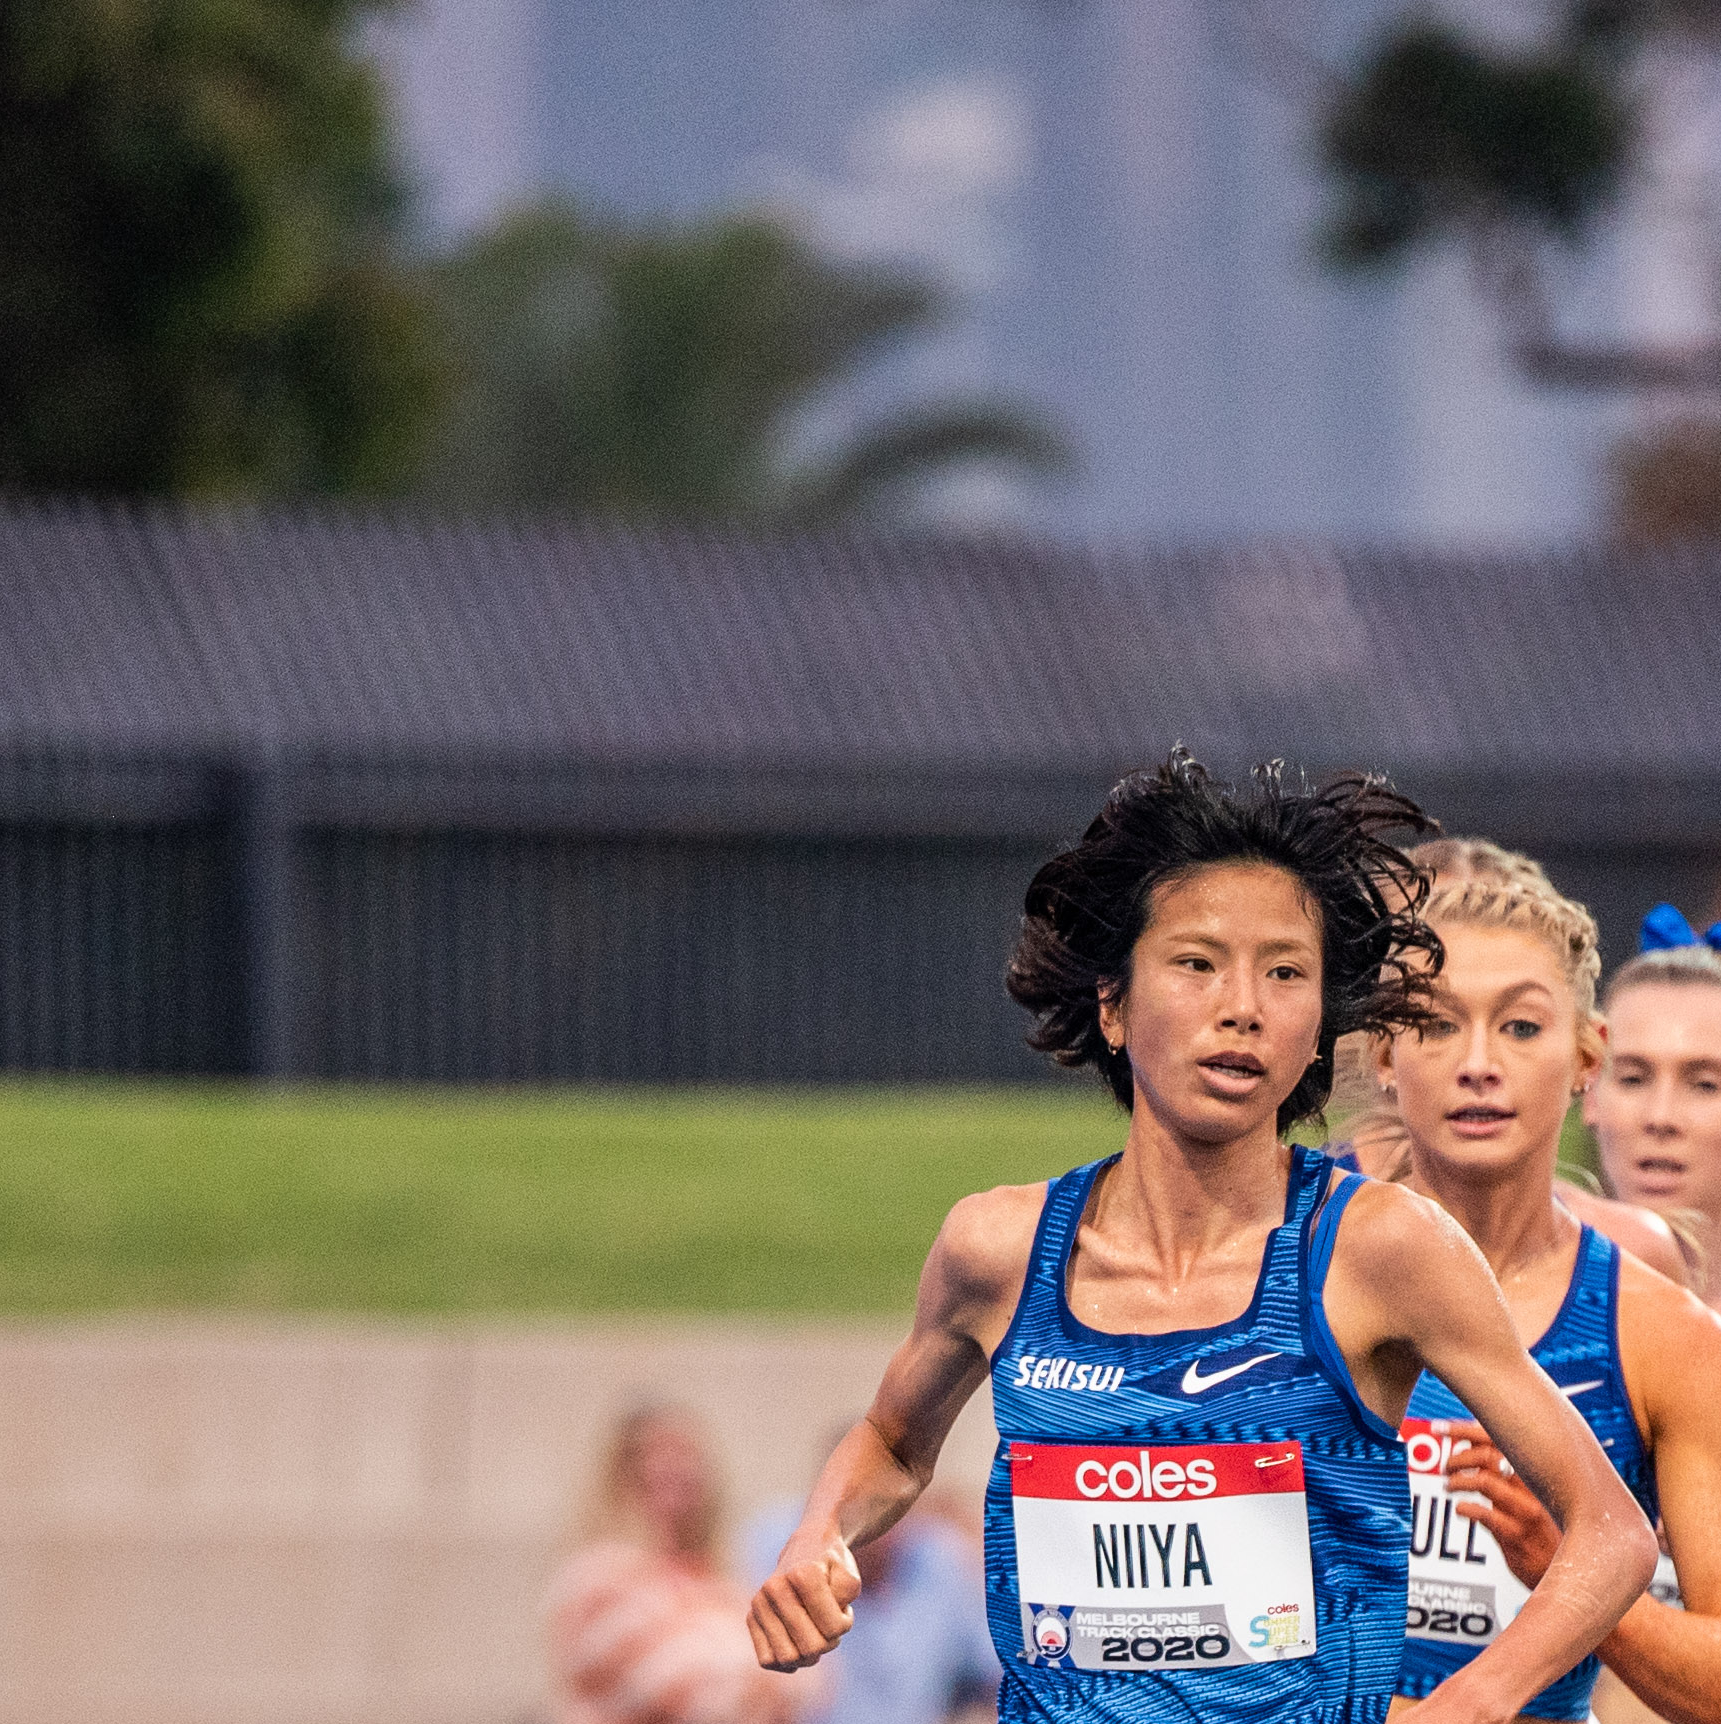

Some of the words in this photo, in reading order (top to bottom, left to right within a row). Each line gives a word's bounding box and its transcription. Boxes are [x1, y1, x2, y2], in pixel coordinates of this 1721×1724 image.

[1012, 1355, 1126, 1392] SEKISUI
[1074, 1449, 1218, 1499] coles
[1409, 1493, 1487, 1565] ULL
[1091, 1521, 1213, 1589] NIIYA
[1076, 1611, 1201, 1627] MELBOURNE
[1267, 1603, 1300, 1616] coles
[1407, 1606, 1494, 1637] 020
[1077, 1624, 1132, 1639] TRACK
[1138, 1624, 1221, 1640] CLASSIC
[1101, 1634, 1232, 1663] 2020
